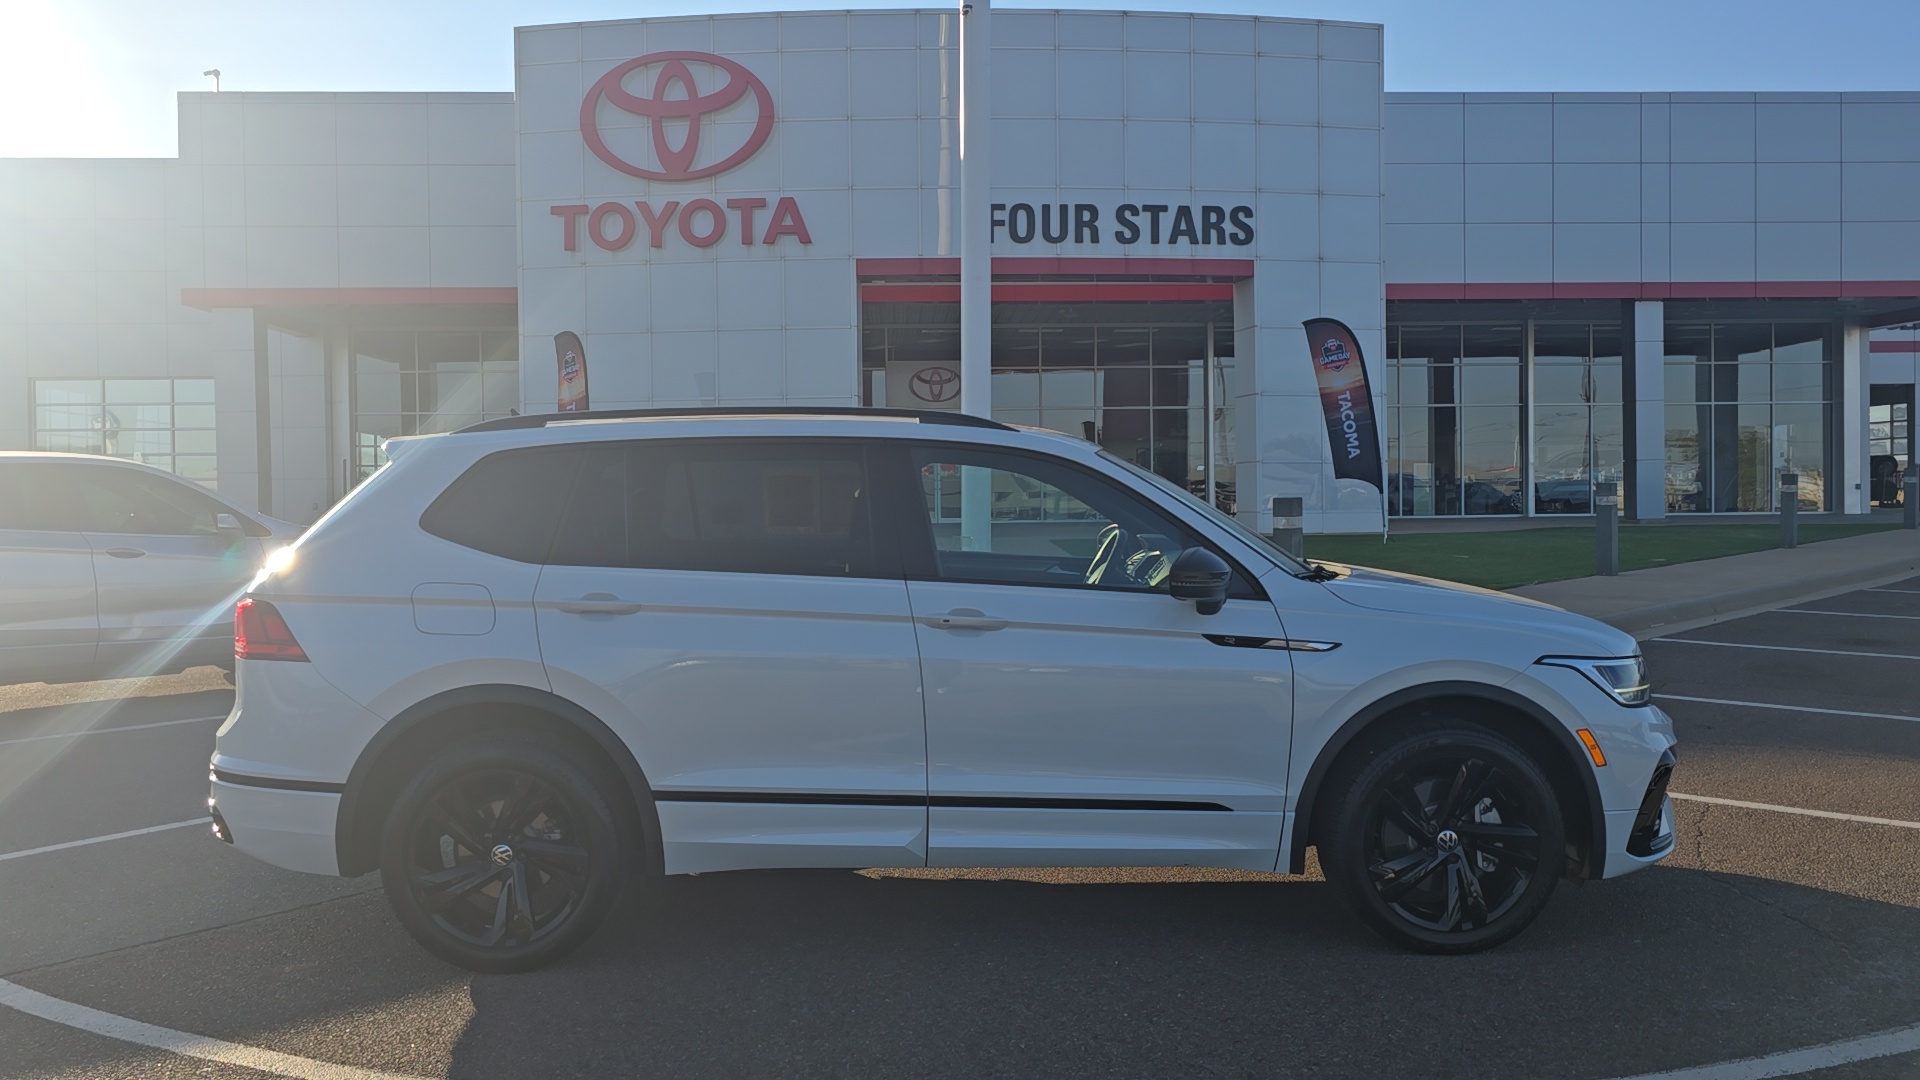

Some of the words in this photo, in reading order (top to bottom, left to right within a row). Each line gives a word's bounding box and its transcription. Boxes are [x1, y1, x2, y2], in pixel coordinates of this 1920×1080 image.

[551, 197, 813, 251] TOYOTA
[990, 203, 1100, 244] FOUR
[1114, 204, 1255, 246] STARS
[1319, 351, 1351, 366] GAMEDAY
[1337, 390, 1361, 459] TACOMA
